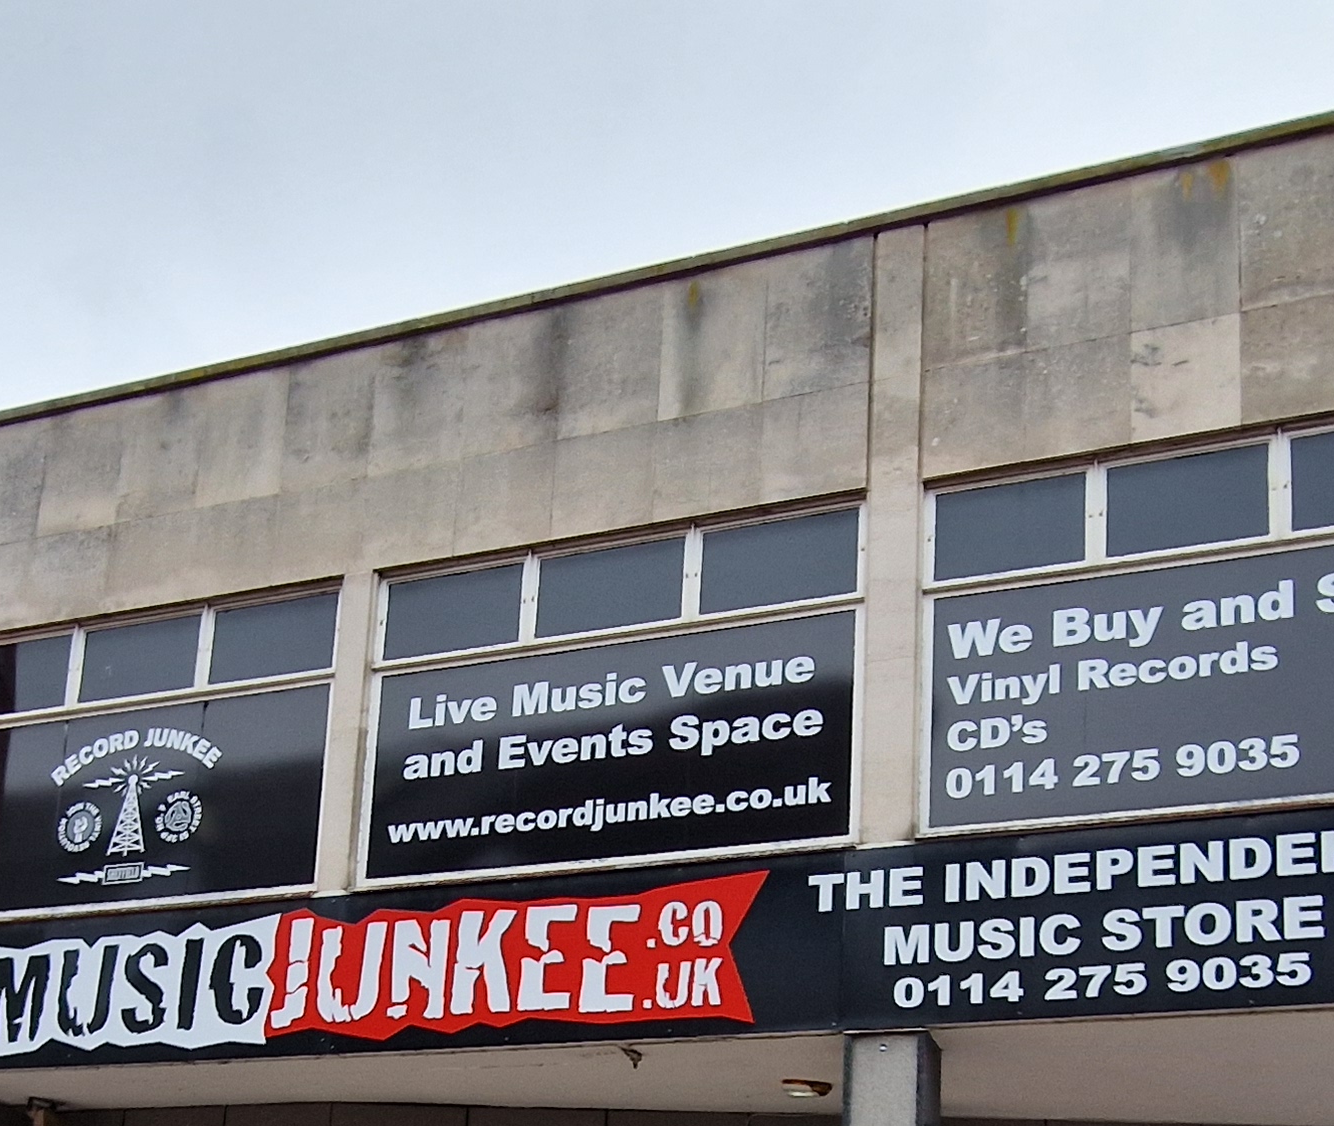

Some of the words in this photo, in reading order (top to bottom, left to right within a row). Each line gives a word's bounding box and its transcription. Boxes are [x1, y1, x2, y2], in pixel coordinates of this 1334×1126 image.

[948, 618, 1033, 660] We
[1052, 606, 1164, 648] Buy
[1181, 579, 1295, 631] and
[408, 693, 497, 730] Live
[511, 672, 647, 718] Music
[661, 655, 815, 698] Venue
[946, 663, 1061, 706] Vinyl
[1077, 640, 1279, 692] Records
[50, 729, 140, 787] RECORD
[143, 727, 223, 769] JUNKEE
[403, 739, 484, 780] and
[498, 723, 653, 770] Events
[668, 708, 824, 756] Space
[946, 713, 1048, 752] CD's
[945, 758, 1059, 799] 0114
[1072, 748, 1161, 787] 275
[1175, 733, 1300, 777] 9035
[387, 777, 832, 844] www.recordjunkee.co.uk
[808, 866, 924, 912] THE
[883, 913, 1081, 966] MUSIC
[1101, 894, 1325, 951] STORE
[893, 970, 1024, 1008] 0114
[1044, 962, 1147, 1001] 275
[1165, 952, 1312, 992] 9035
